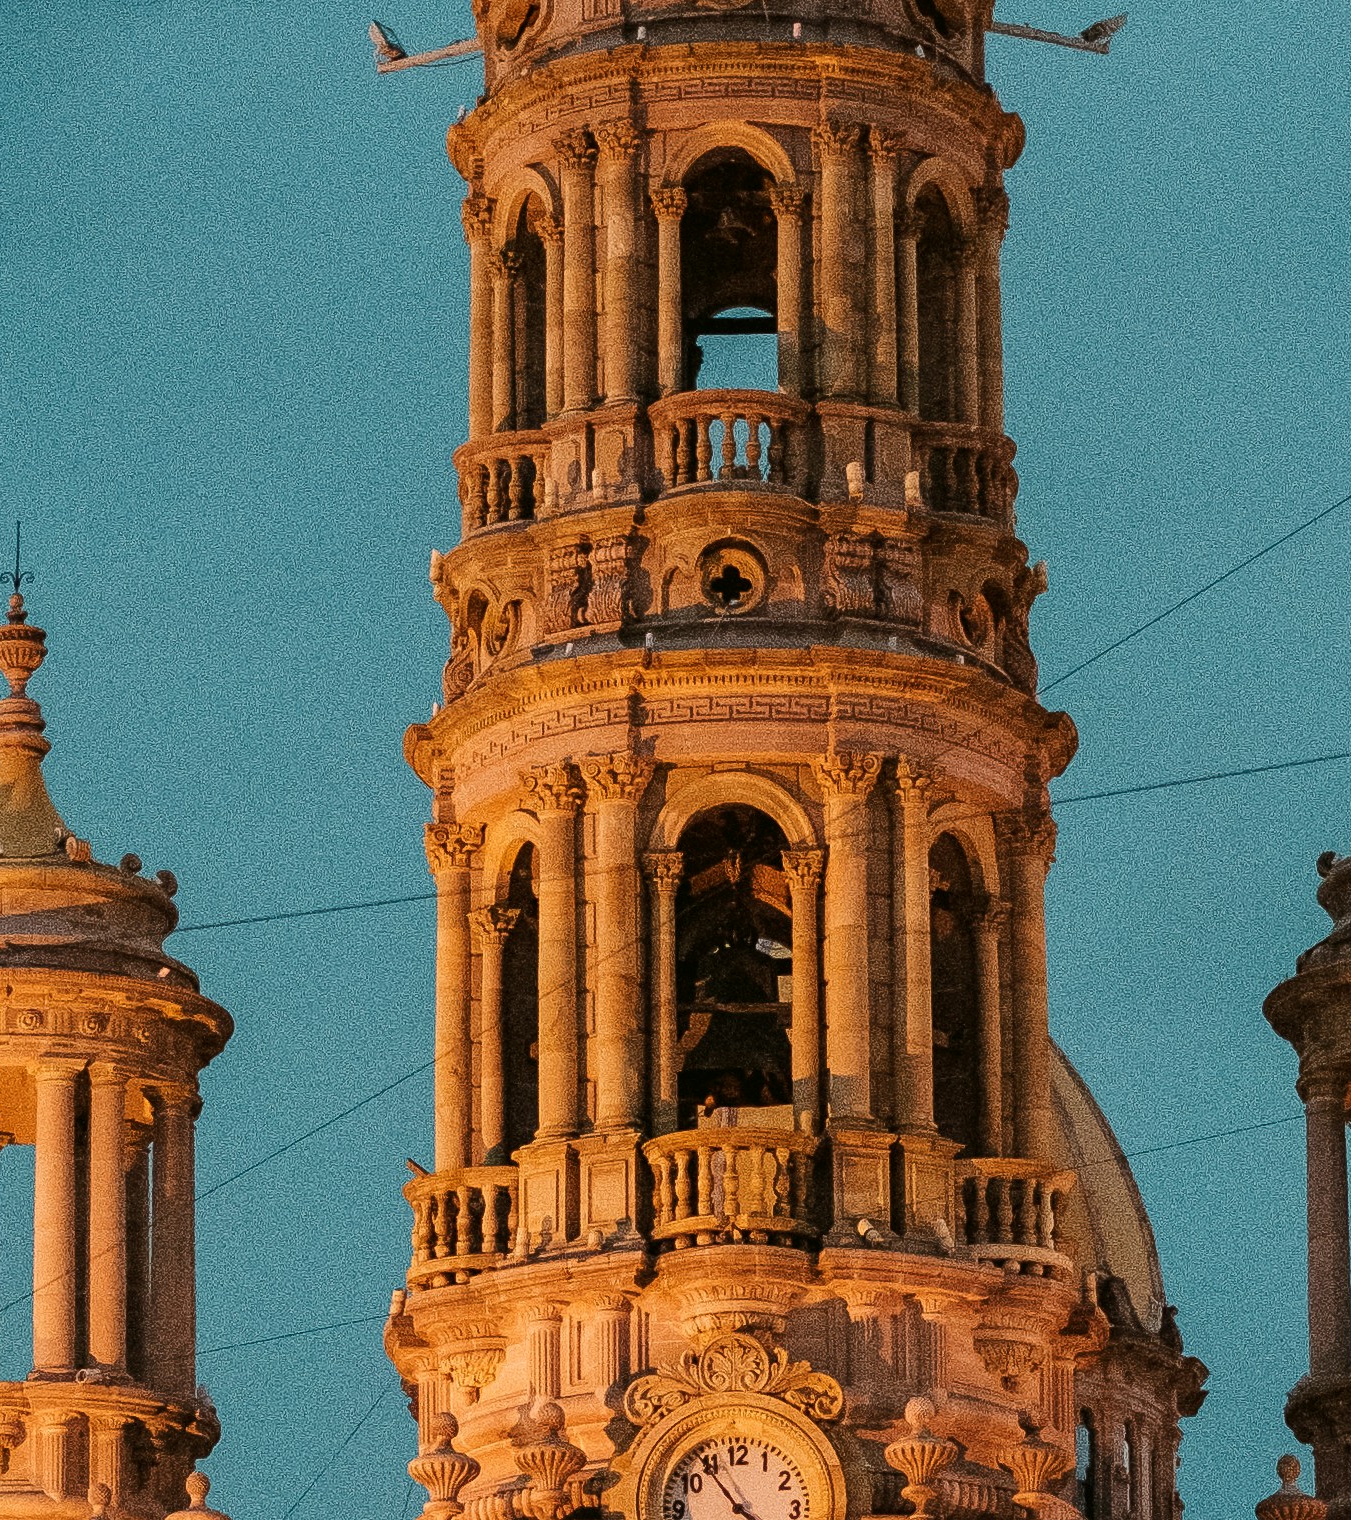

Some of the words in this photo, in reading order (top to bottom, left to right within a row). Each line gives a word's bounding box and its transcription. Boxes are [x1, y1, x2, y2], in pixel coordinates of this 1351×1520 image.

[727, 1444, 749, 1466] 12
[761, 1450, 768, 1472] 1
[682, 1473, 703, 1494] 10
[778, 1471, 792, 1492] 2
[672, 1499, 685, 1520] 9
[788, 1499, 801, 1520] 3
